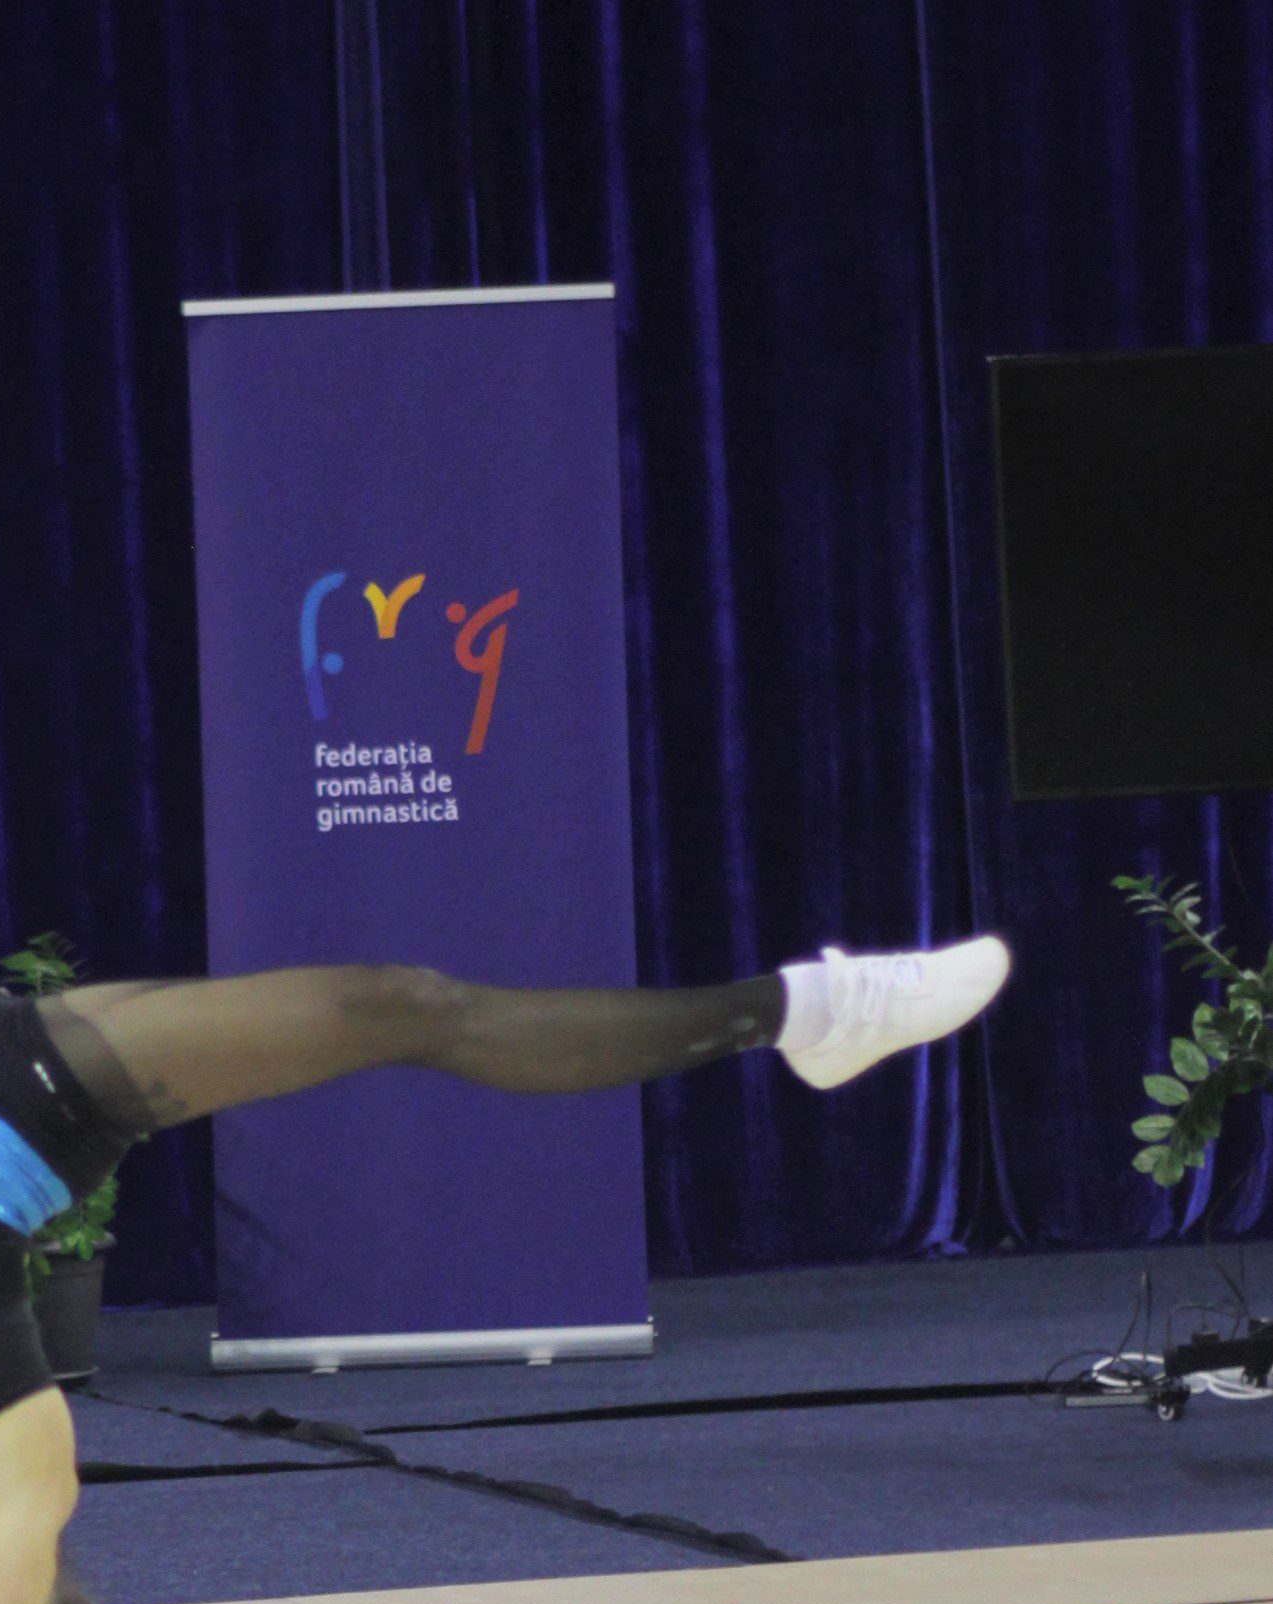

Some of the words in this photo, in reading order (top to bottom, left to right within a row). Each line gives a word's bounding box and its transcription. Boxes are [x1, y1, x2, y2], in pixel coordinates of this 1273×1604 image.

[314, 741, 432, 769] federația
[315, 772, 415, 798] română
[420, 770, 453, 793] de
[316, 798, 459, 832] gimnastică
